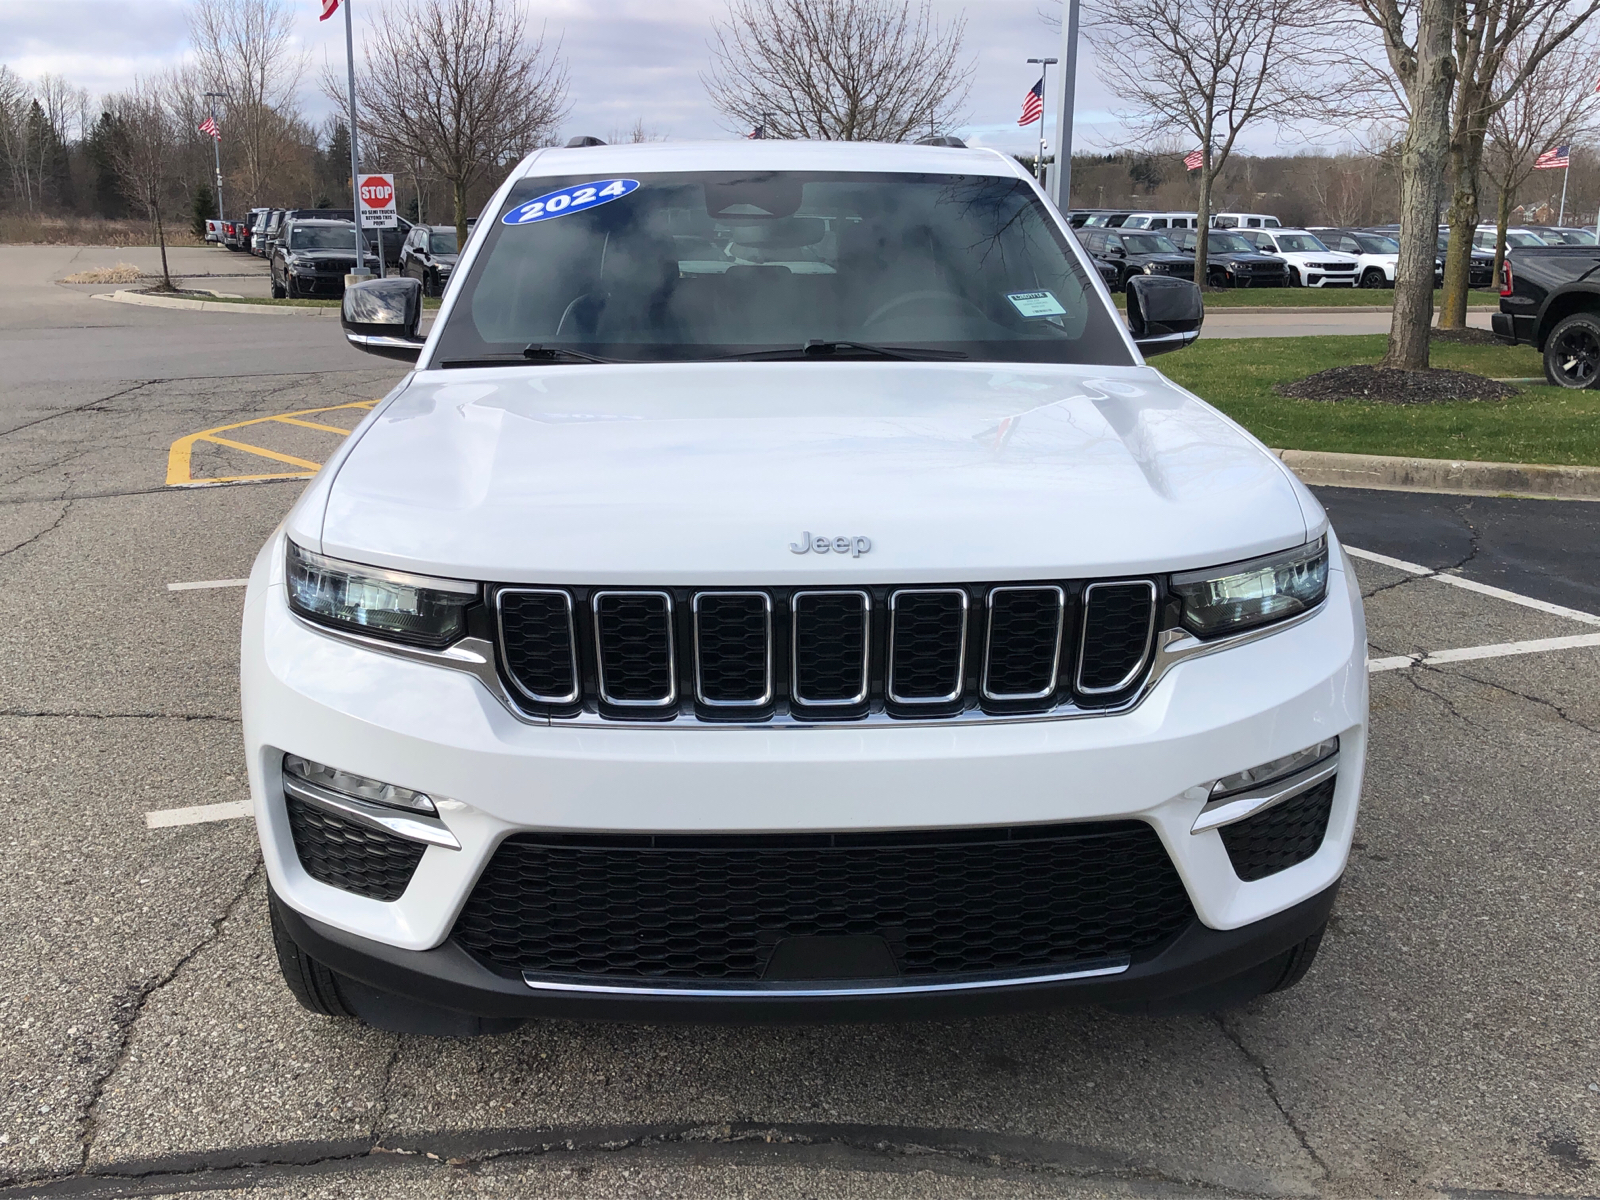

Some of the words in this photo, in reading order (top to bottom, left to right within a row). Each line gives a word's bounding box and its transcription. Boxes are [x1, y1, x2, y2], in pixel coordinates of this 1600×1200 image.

[361, 186, 392, 199] STOP
[518, 180, 626, 223] 2024
[789, 531, 871, 558] Jeep
